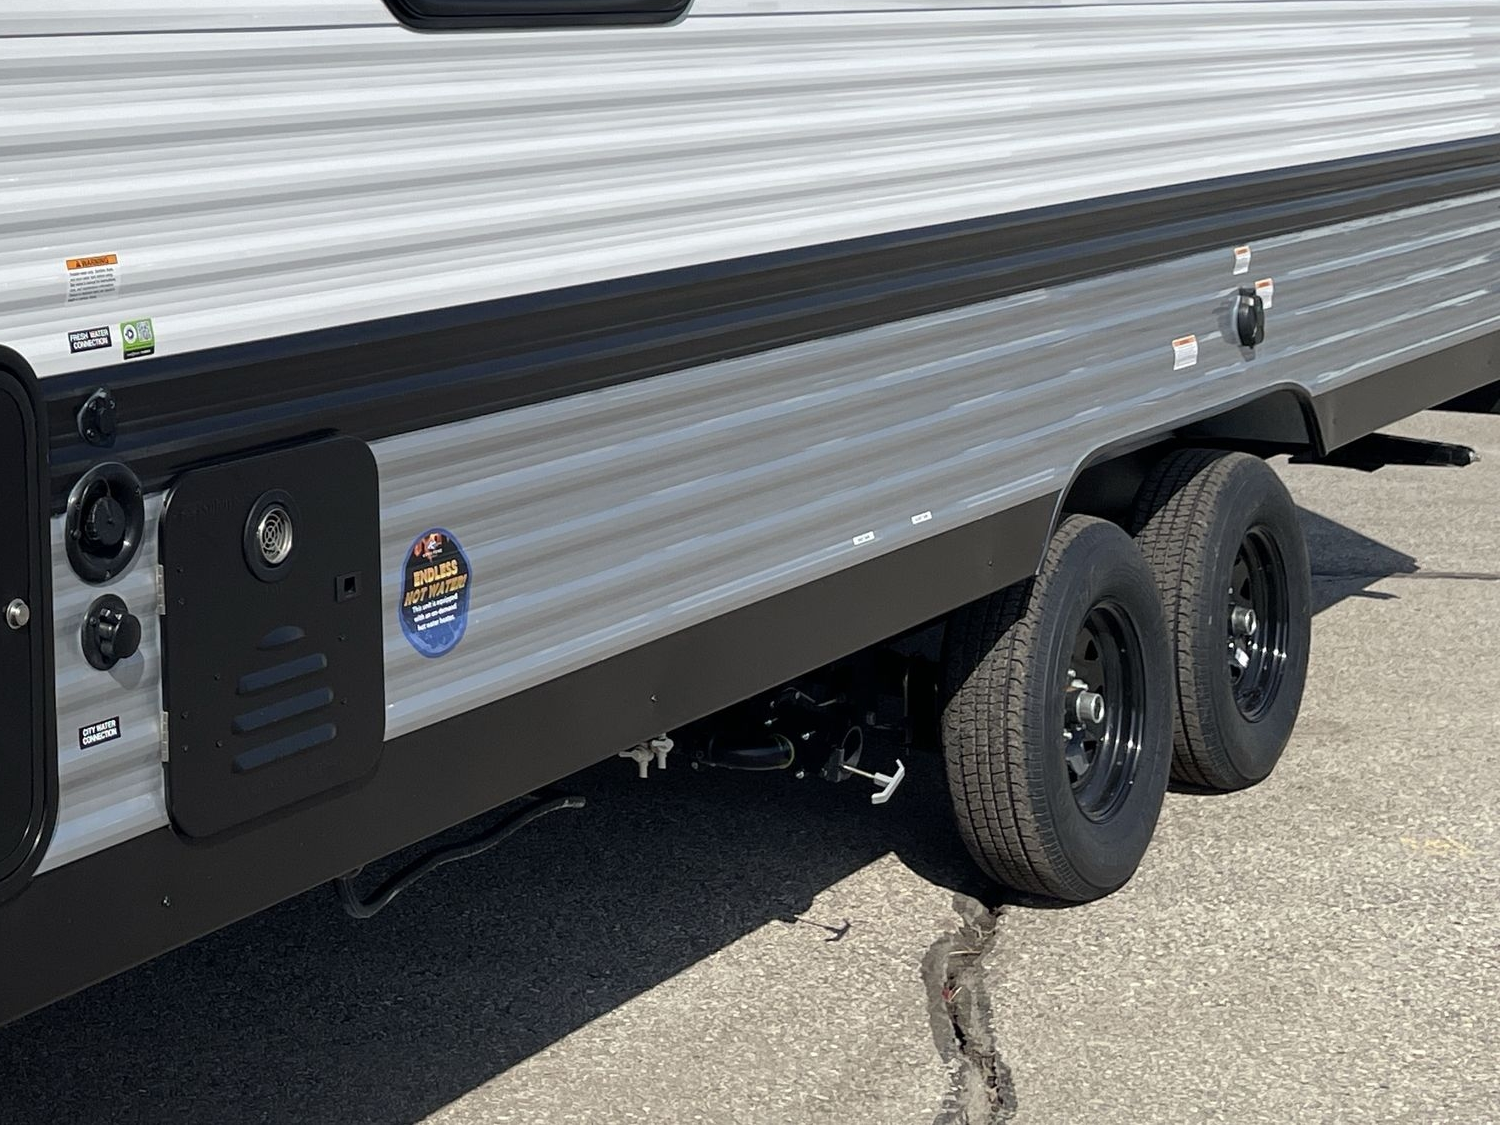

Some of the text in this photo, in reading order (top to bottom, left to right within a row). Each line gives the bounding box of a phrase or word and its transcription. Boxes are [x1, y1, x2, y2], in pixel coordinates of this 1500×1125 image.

[81, 256, 109, 268] WARNING
[70, 329, 109, 342] FRESH WATER
[73, 337, 108, 349] CONNECTION
[413, 559, 458, 587] ENDLESS
[404, 574, 468, 607] HOT WATER!
[83, 720, 116, 736] CITY WATER
[82, 728, 117, 745] CONNECTION
